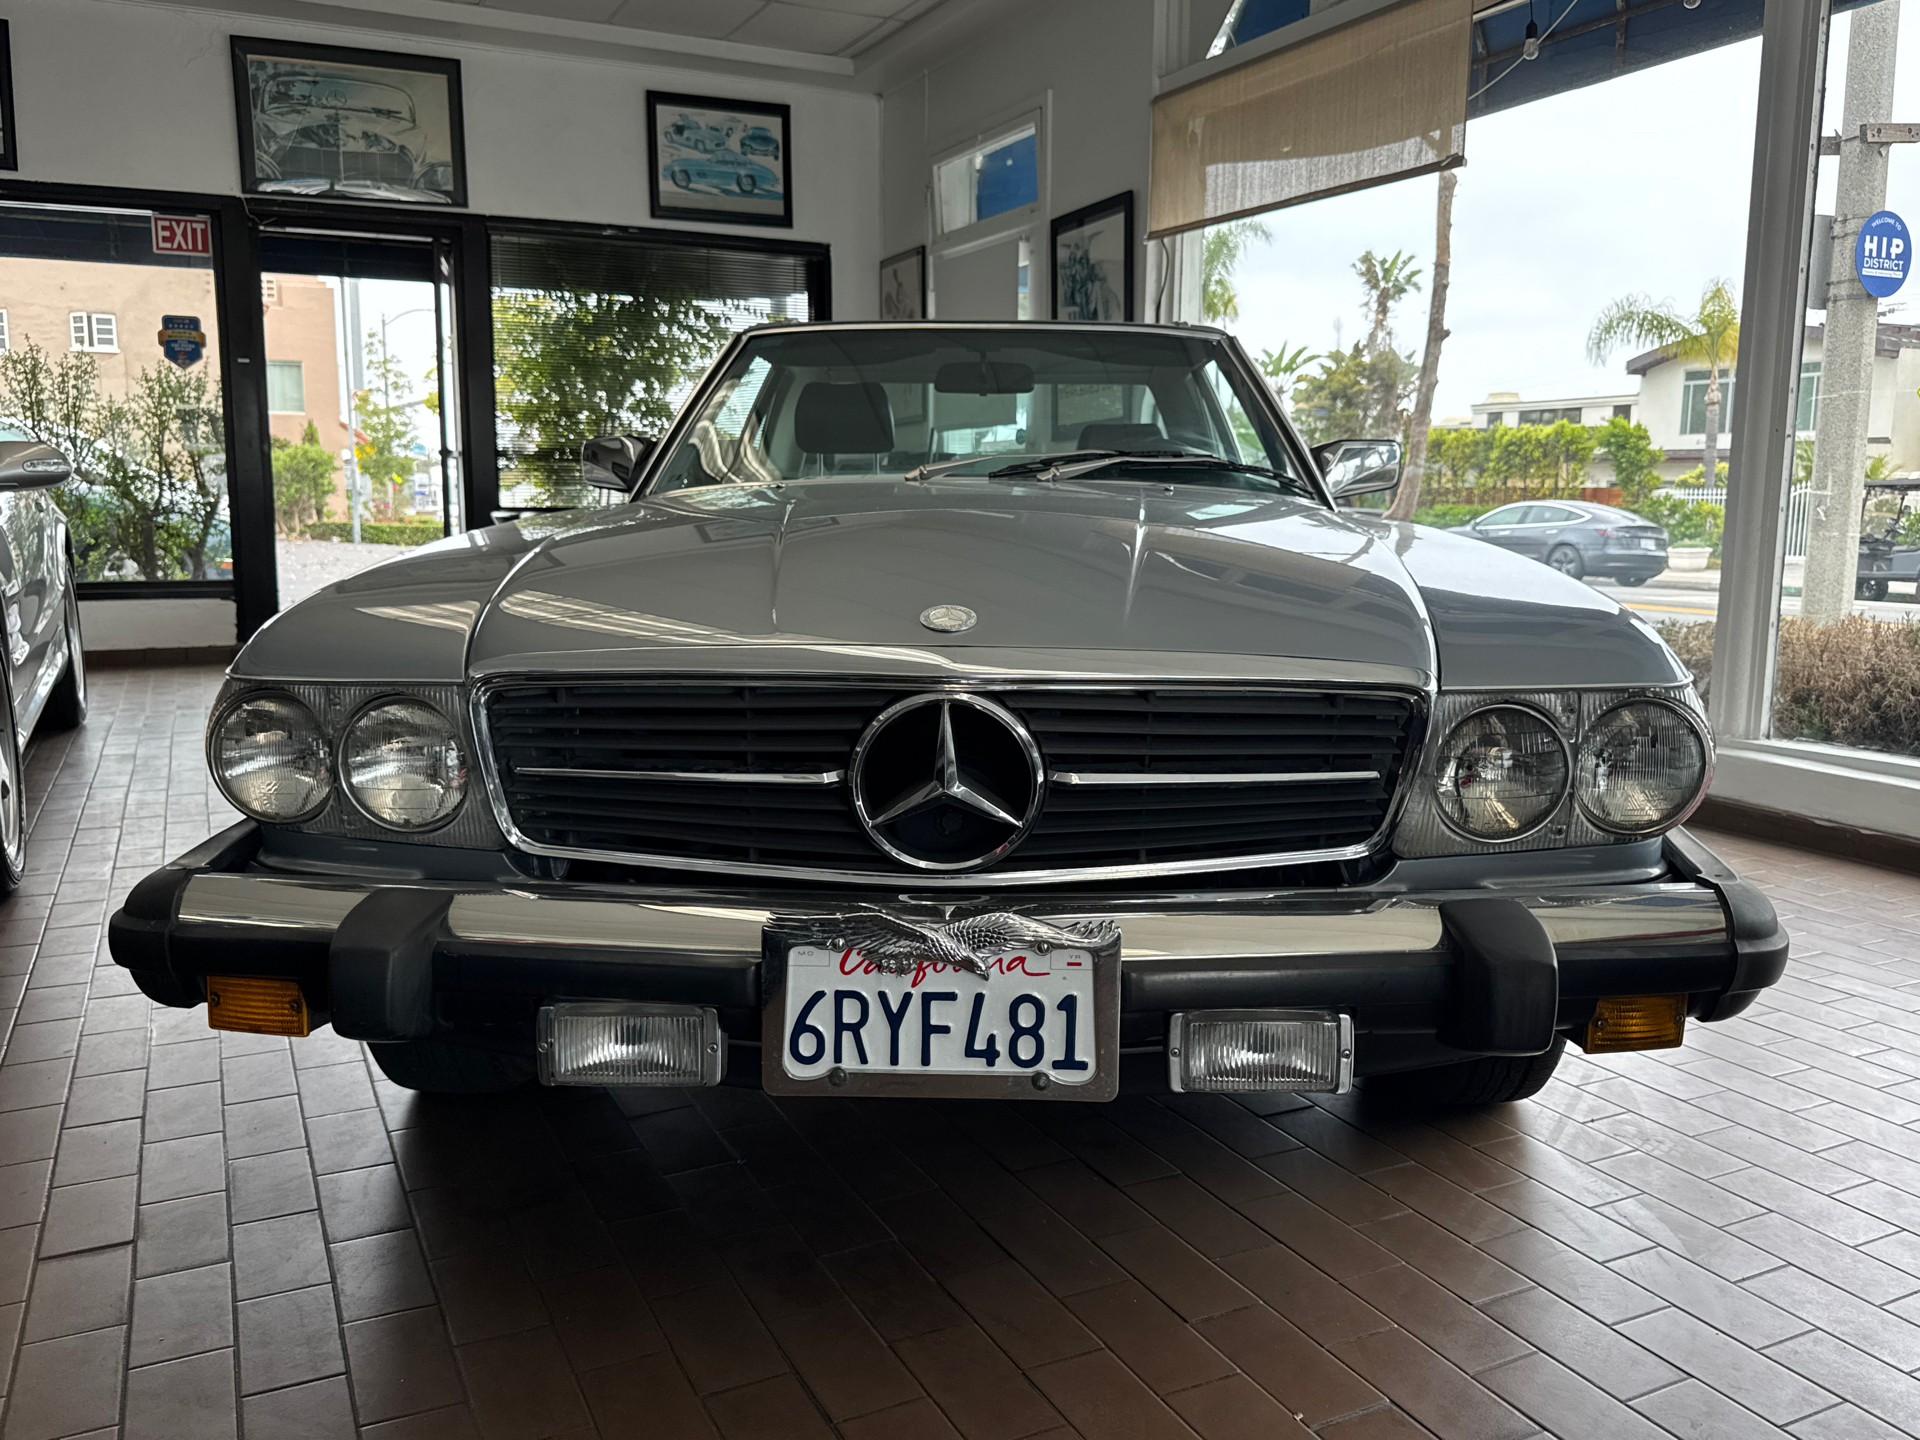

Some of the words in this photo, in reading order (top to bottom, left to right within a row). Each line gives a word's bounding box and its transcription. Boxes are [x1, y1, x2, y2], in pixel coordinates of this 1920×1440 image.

[156, 219, 206, 251] EXIT
[1871, 216, 1895, 228] WELCOME
[1895, 221, 1902, 231] TO
[1864, 234, 1904, 260] HIP
[1863, 257, 1904, 271] DISTRICT
[789, 989, 1089, 1071] 6RYF481
